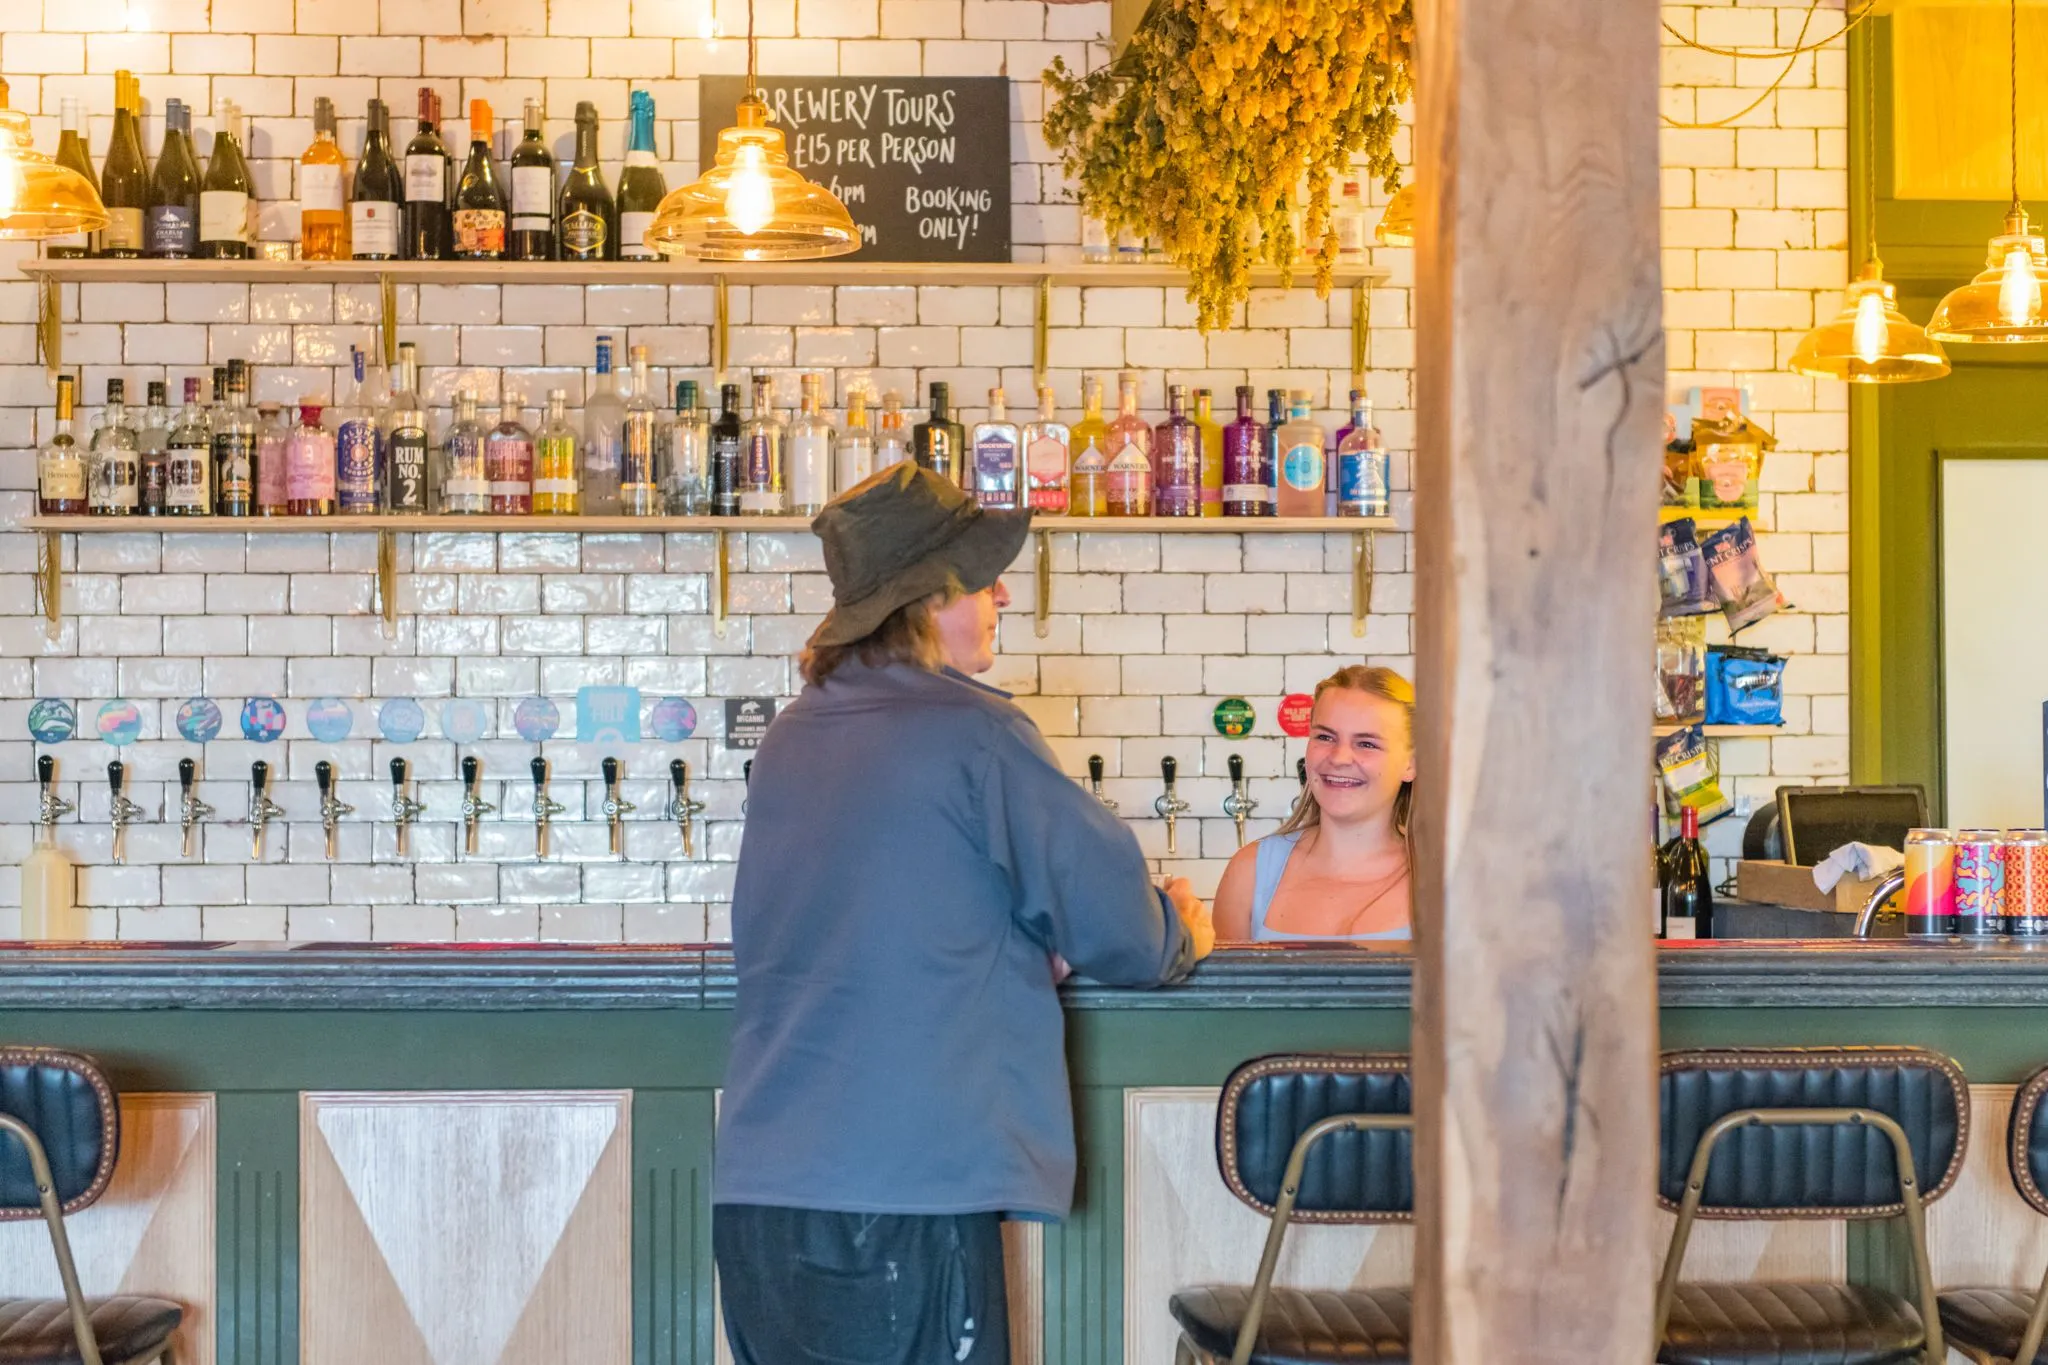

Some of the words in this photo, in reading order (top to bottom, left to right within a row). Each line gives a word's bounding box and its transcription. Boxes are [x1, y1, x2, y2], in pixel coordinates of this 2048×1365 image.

[756, 84, 877, 130] BREWERY
[882, 88, 956, 134] TOURS
[794, 133, 831, 168] £15
[837, 138, 875, 168] PER
[881, 132, 956, 174] PERSON
[905, 186, 991, 215] BOOKING
[919, 213, 979, 250] ONLY!
[395, 446, 424, 465] RUM
[398, 463, 422, 479] NO.
[402, 479, 417, 506] 2
